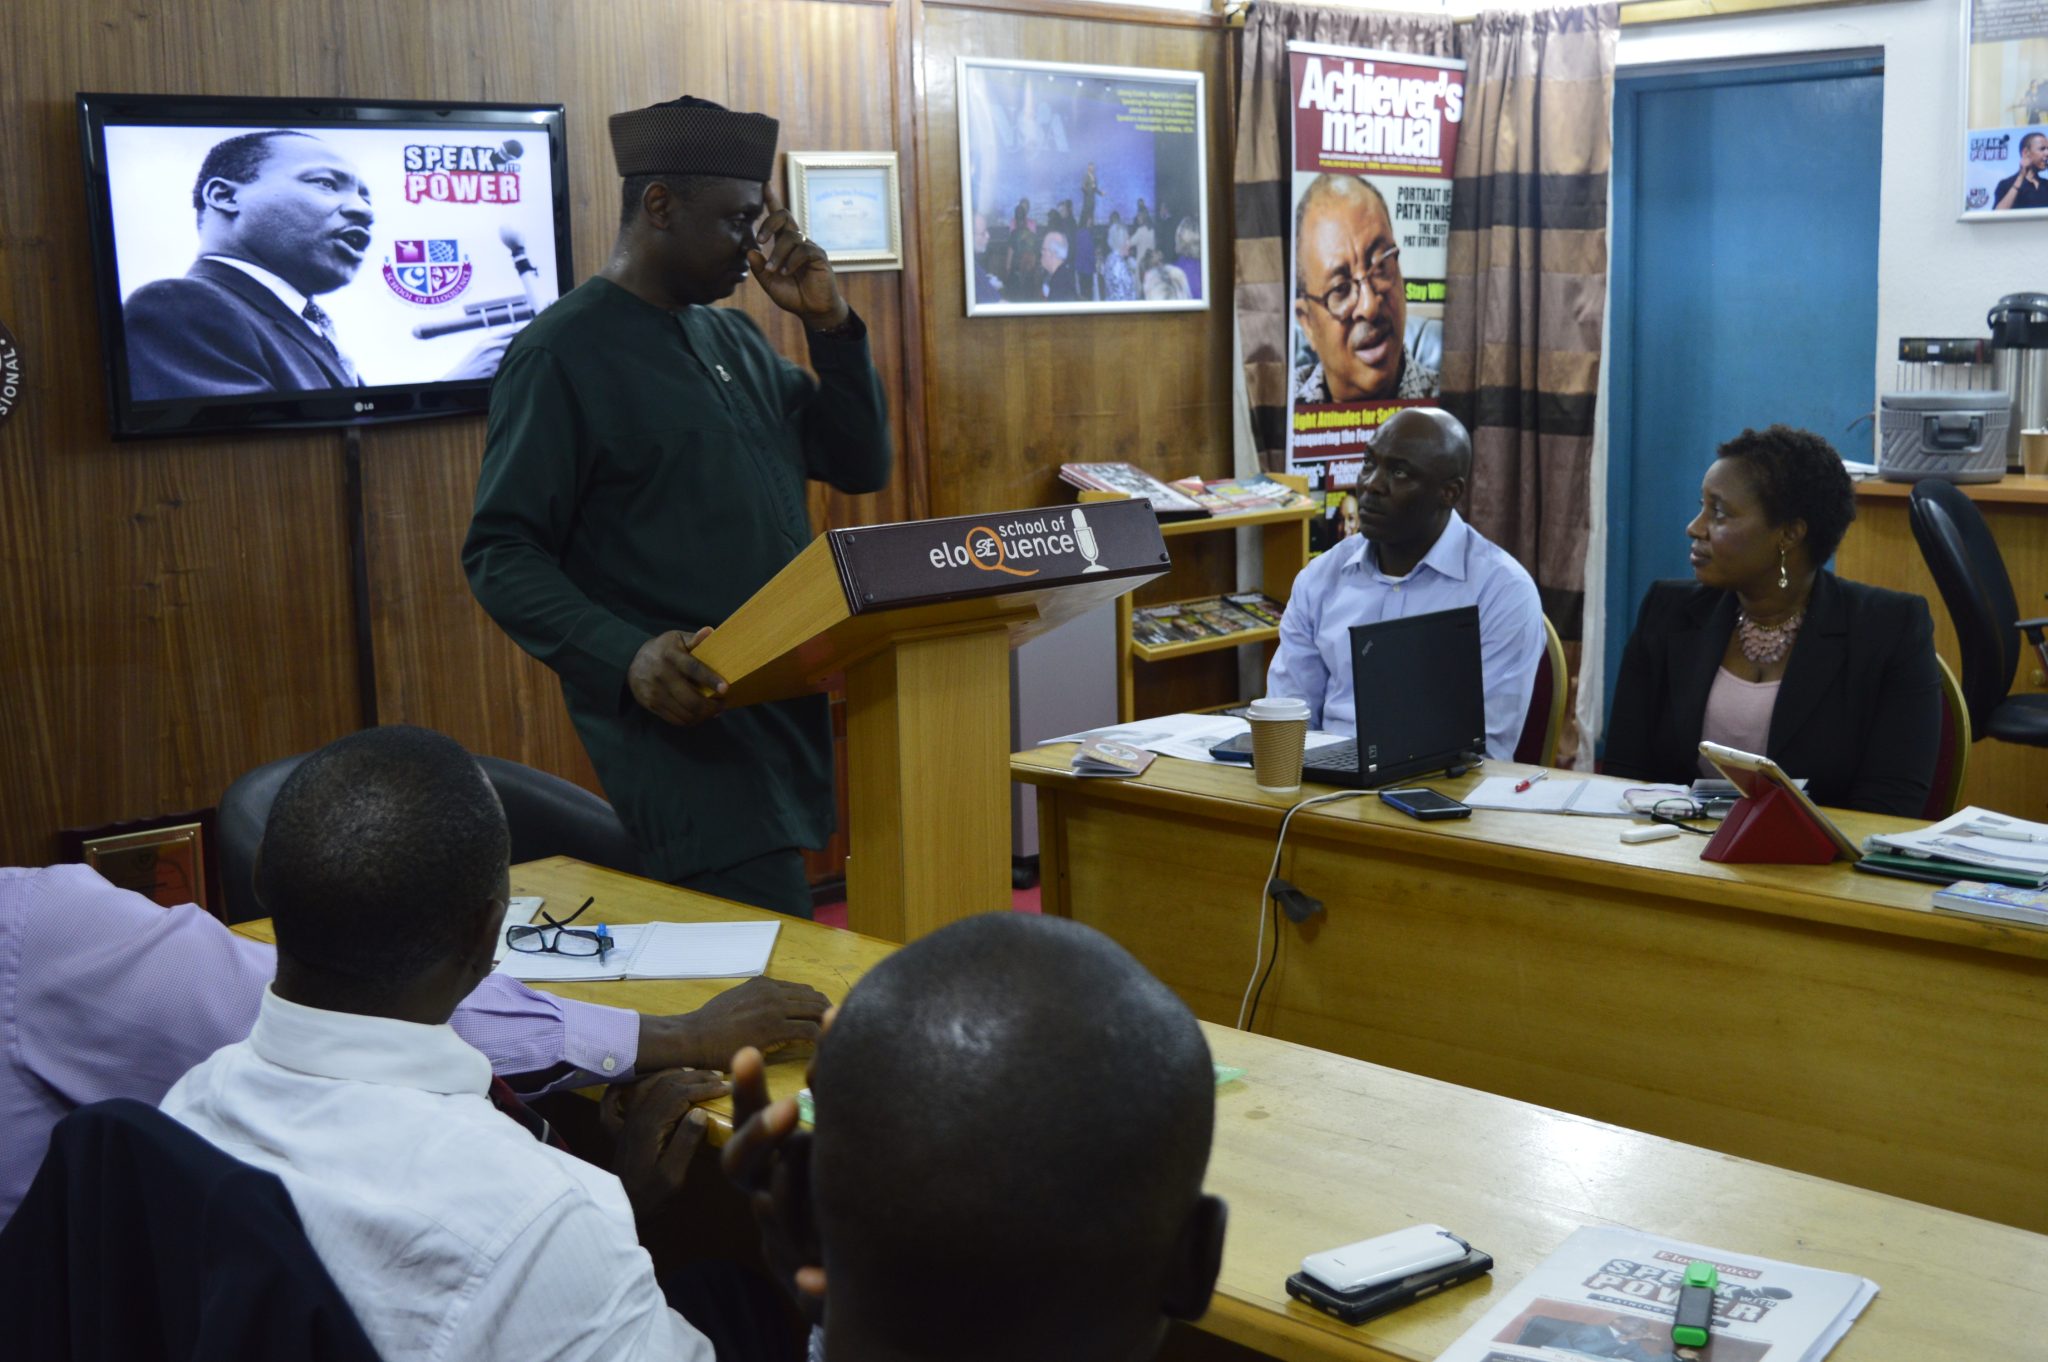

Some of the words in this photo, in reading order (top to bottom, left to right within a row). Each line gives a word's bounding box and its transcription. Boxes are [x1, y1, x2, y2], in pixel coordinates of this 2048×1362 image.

[1298, 57, 1463, 123] Achiever's
[1321, 110, 1441, 158] manual
[405, 145, 495, 171] SPEAK
[406, 173, 519, 202] POWER
[1397, 186, 1441, 201] PORTRAIT
[1396, 203, 1421, 220] PATH
[1424, 204, 1452, 221] FINDE
[1405, 281, 1427, 301] Stay
[1362, 408, 1376, 425] for
[1294, 431, 1340, 447] onquering
[998, 518, 1048, 537] school
[1051, 516, 1066, 532] of
[1658, 1250, 1760, 1279] Eloence
[1605, 1260, 1737, 1299] SPEK
